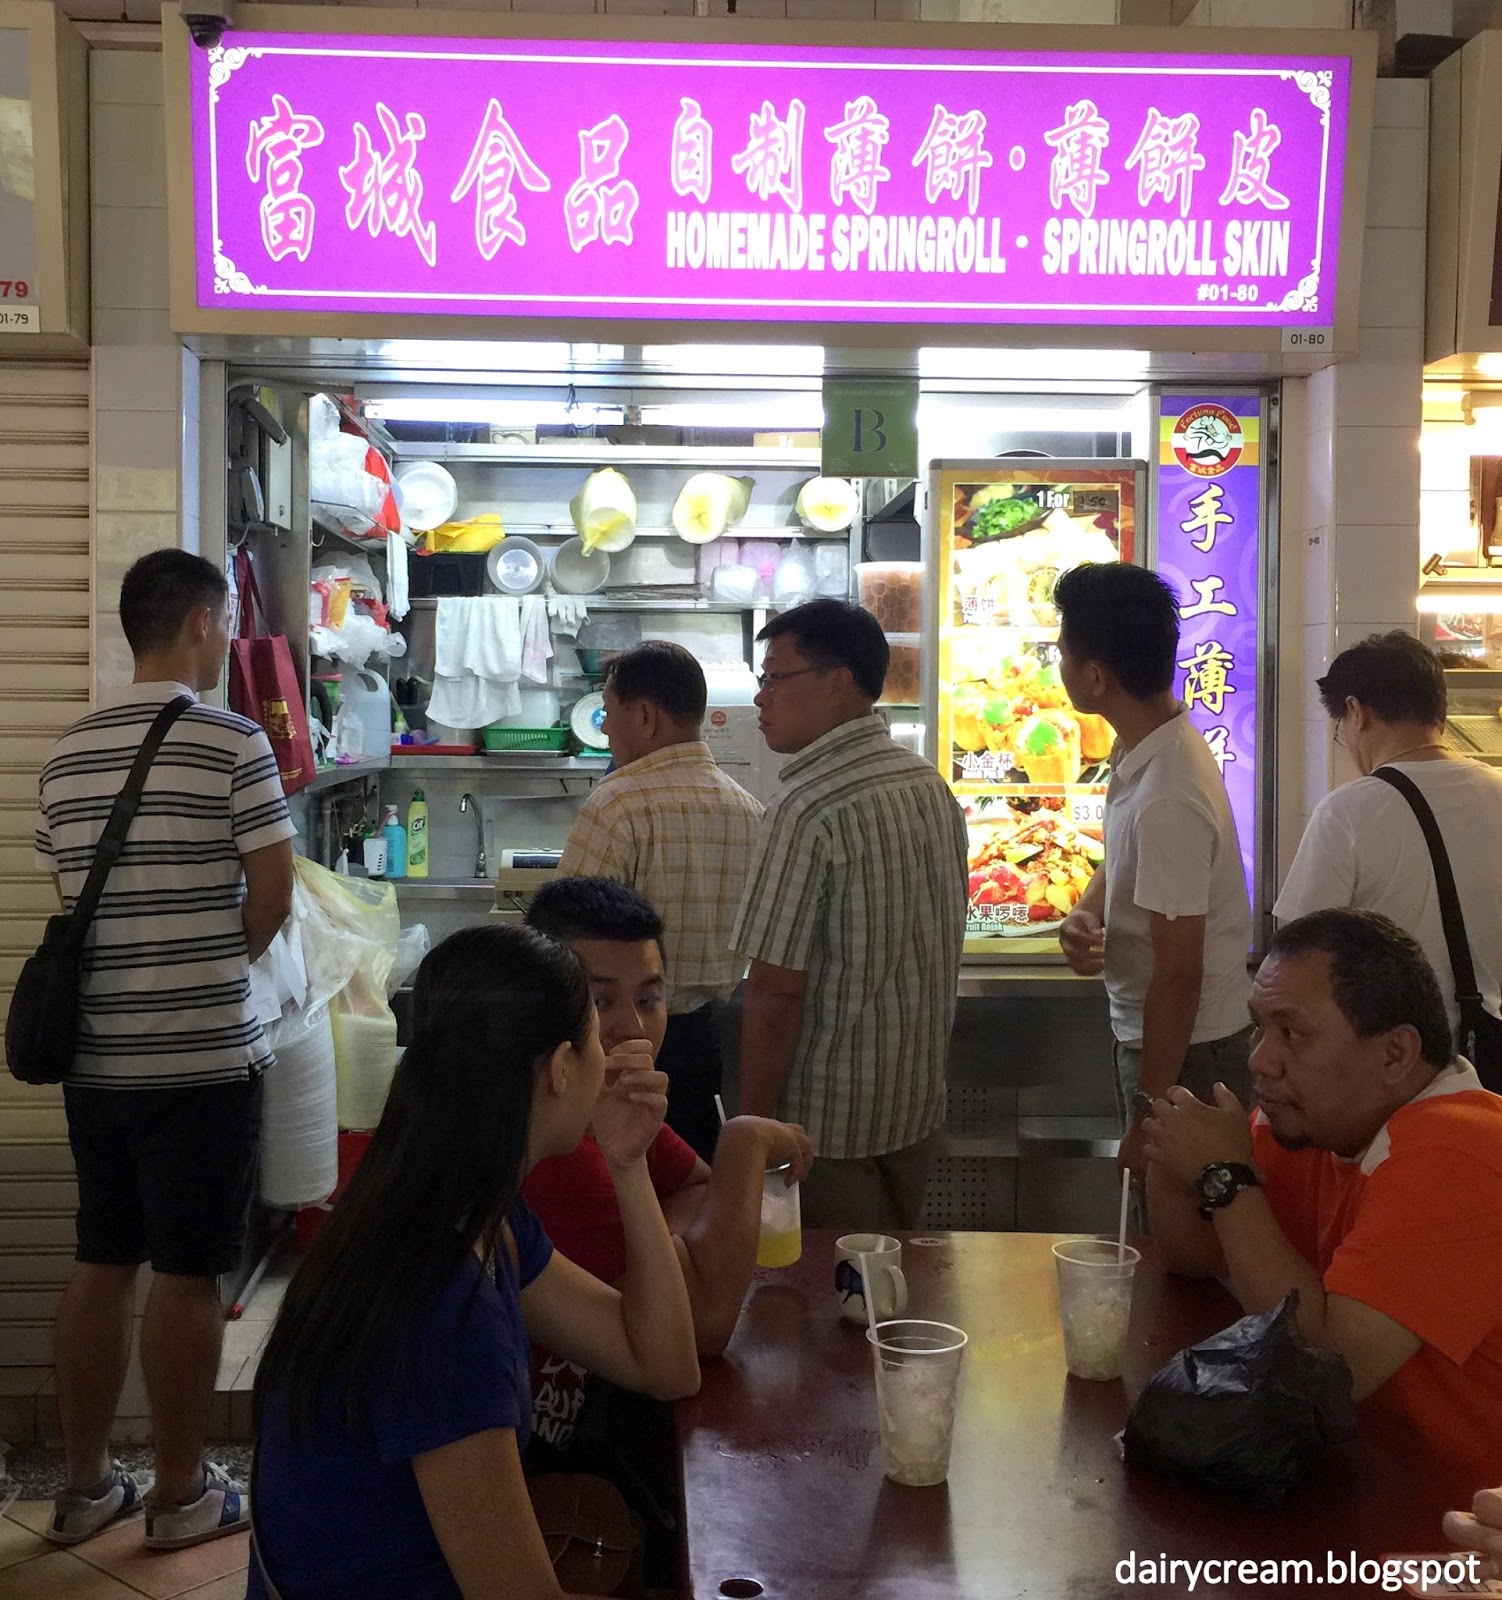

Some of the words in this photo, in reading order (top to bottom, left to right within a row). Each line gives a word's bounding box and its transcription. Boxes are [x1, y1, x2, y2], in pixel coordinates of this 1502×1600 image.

[666, 211, 826, 271] HOMEMADE
[831, 214, 1006, 274] SPRINGROLL
[1042, 217, 1217, 276] SPRINGROLL
[1223, 220, 1291, 277] SKIN
[1197, 284, 1259, 302] #01-80
[1290, 333, 1325, 345] 01-80
[1216, 409, 1238, 430] Food
[852, 409, 887, 452] B
[1046, 490, 1070, 508] For
[963, 752, 1012, 769] 小金杯
[966, 922, 980, 931] ruit
